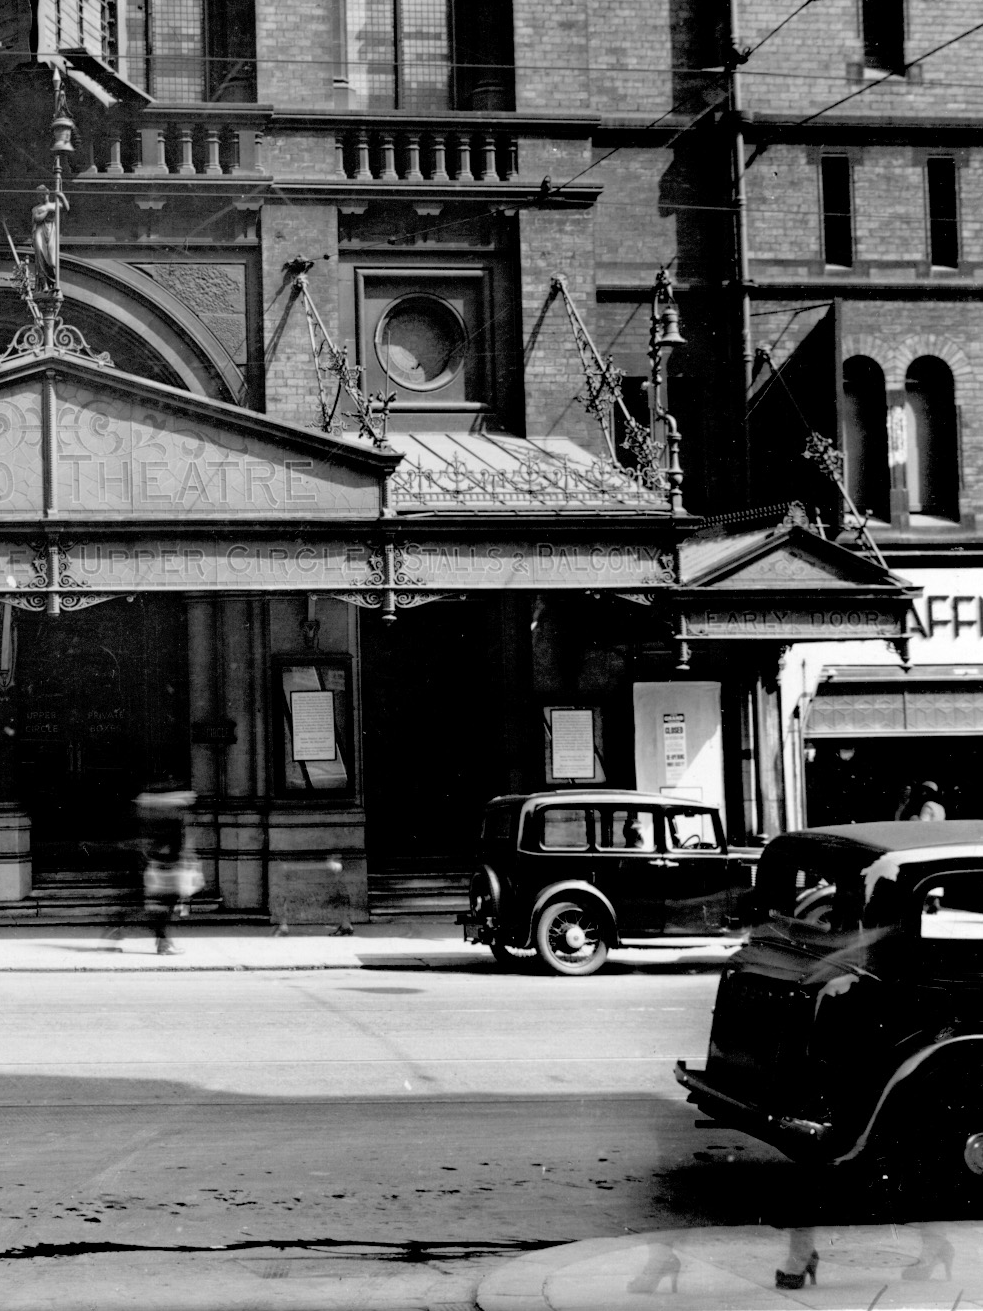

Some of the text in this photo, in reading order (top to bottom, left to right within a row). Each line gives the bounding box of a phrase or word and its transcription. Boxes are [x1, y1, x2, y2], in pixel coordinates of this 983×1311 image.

[57, 453, 318, 507] THEATRE
[79, 544, 368, 578] UPPER CIRCLE
[403, 542, 663, 576] STALLS & BALCONY
[704, 609, 880, 630] EARLY DOOR
[904, 595, 983, 639] AFF
